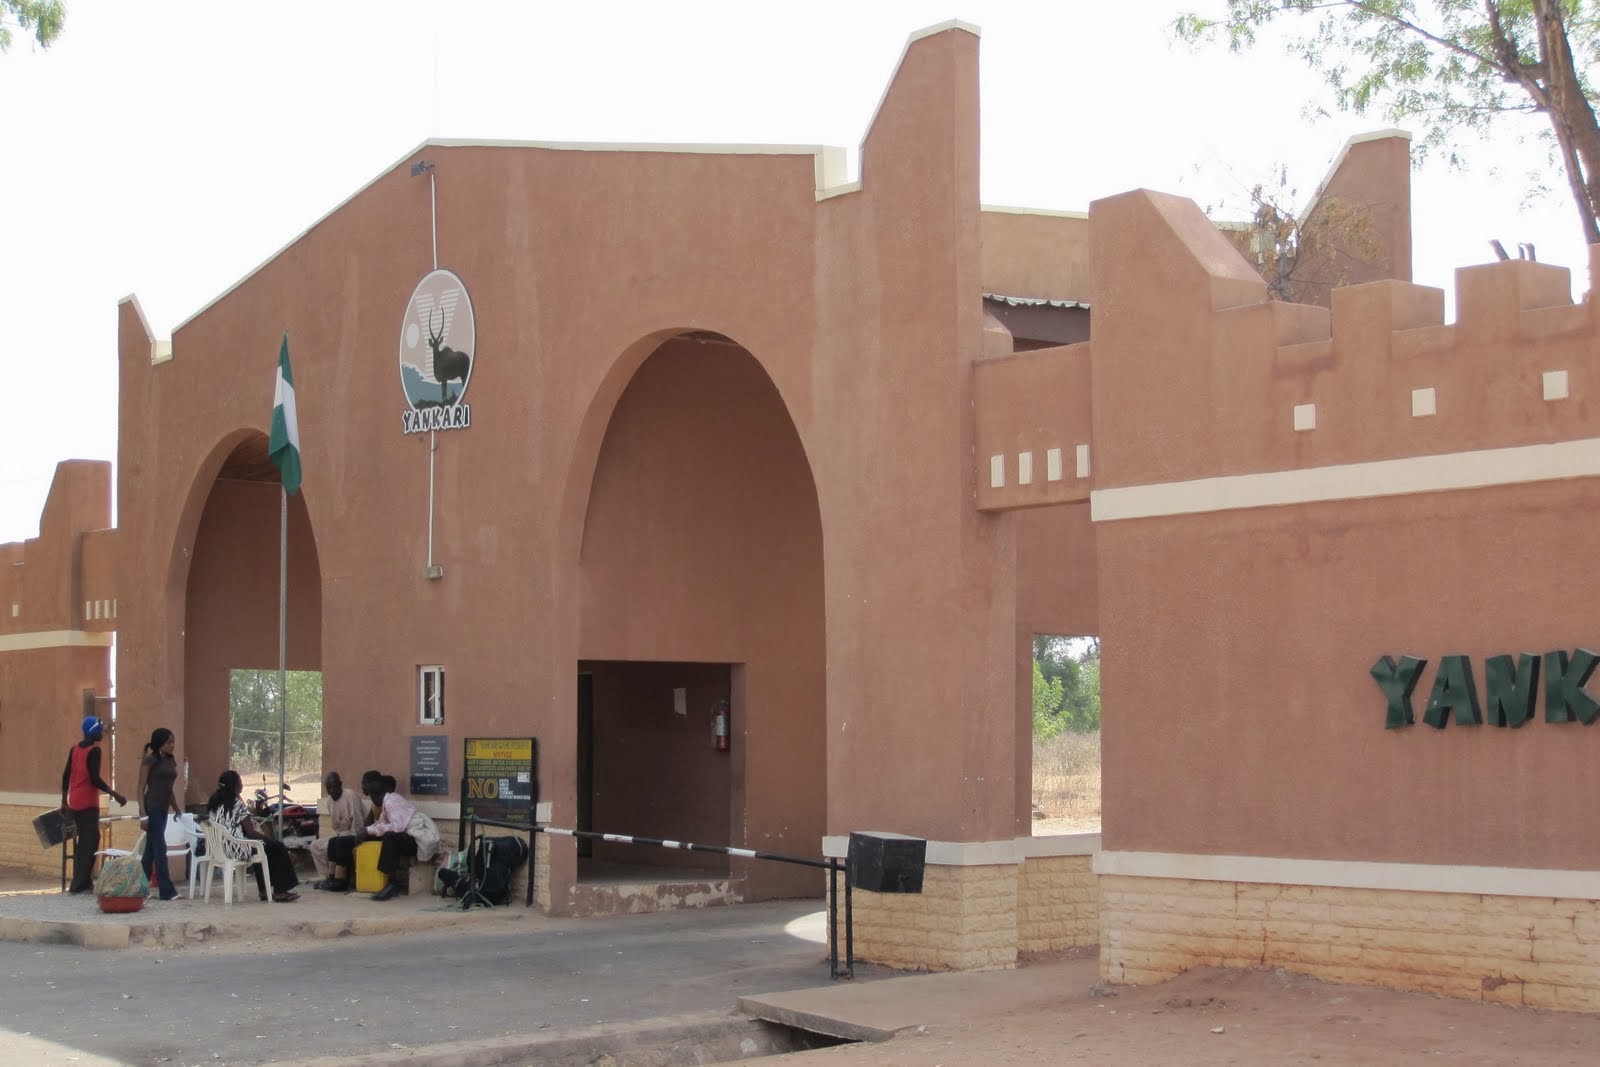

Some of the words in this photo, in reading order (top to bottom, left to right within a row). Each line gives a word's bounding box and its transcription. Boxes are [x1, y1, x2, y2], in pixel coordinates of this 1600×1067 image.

[402, 405, 469, 434] YANKARI
[1370, 648, 1600, 730] YANK
[468, 778, 498, 799] NO
